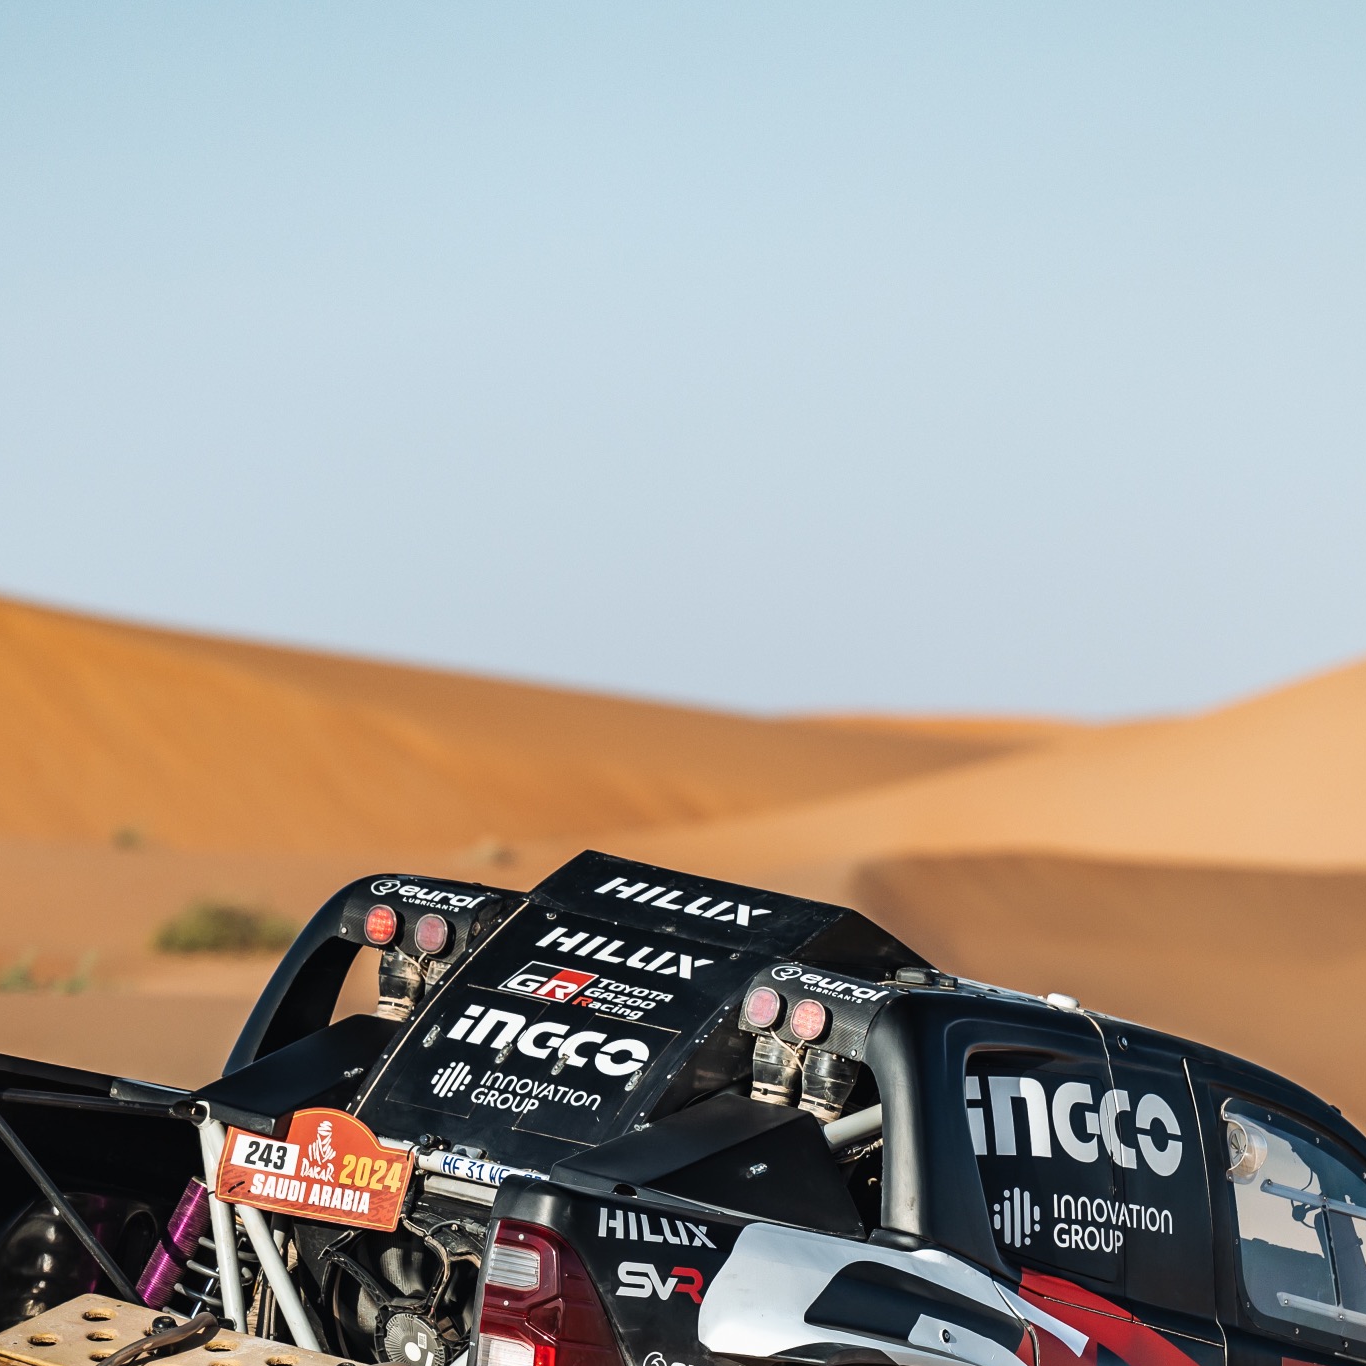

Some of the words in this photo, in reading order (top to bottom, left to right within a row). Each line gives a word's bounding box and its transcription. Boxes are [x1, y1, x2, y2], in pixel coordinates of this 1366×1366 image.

[398, 885, 485, 909] eurol
[402, 897, 460, 912] LUBRICANTS
[594, 877, 771, 927] HILUX
[536, 927, 713, 980] HILUX
[506, 974, 579, 1000] GR
[584, 988, 657, 1010] GAZOO
[598, 978, 674, 1002] TOYOTA
[799, 972, 890, 1001] eurol
[804, 984, 863, 1004] LUBRICANTS
[572, 996, 644, 1020] Racing
[471, 1088, 539, 1114] GROUP
[244, 1140, 288, 1170] 243
[442, 1155, 464, 1176] HF
[466, 1161, 485, 1181] 31
[339, 1154, 403, 1193] 2024
[250, 1173, 307, 1204] SAUDI
[308, 1187, 370, 1214] ARABIA
[598, 1207, 717, 1248] HILUX
[1053, 1223, 1124, 1254] GROUP
[615, 1261, 704, 1304] SVR
